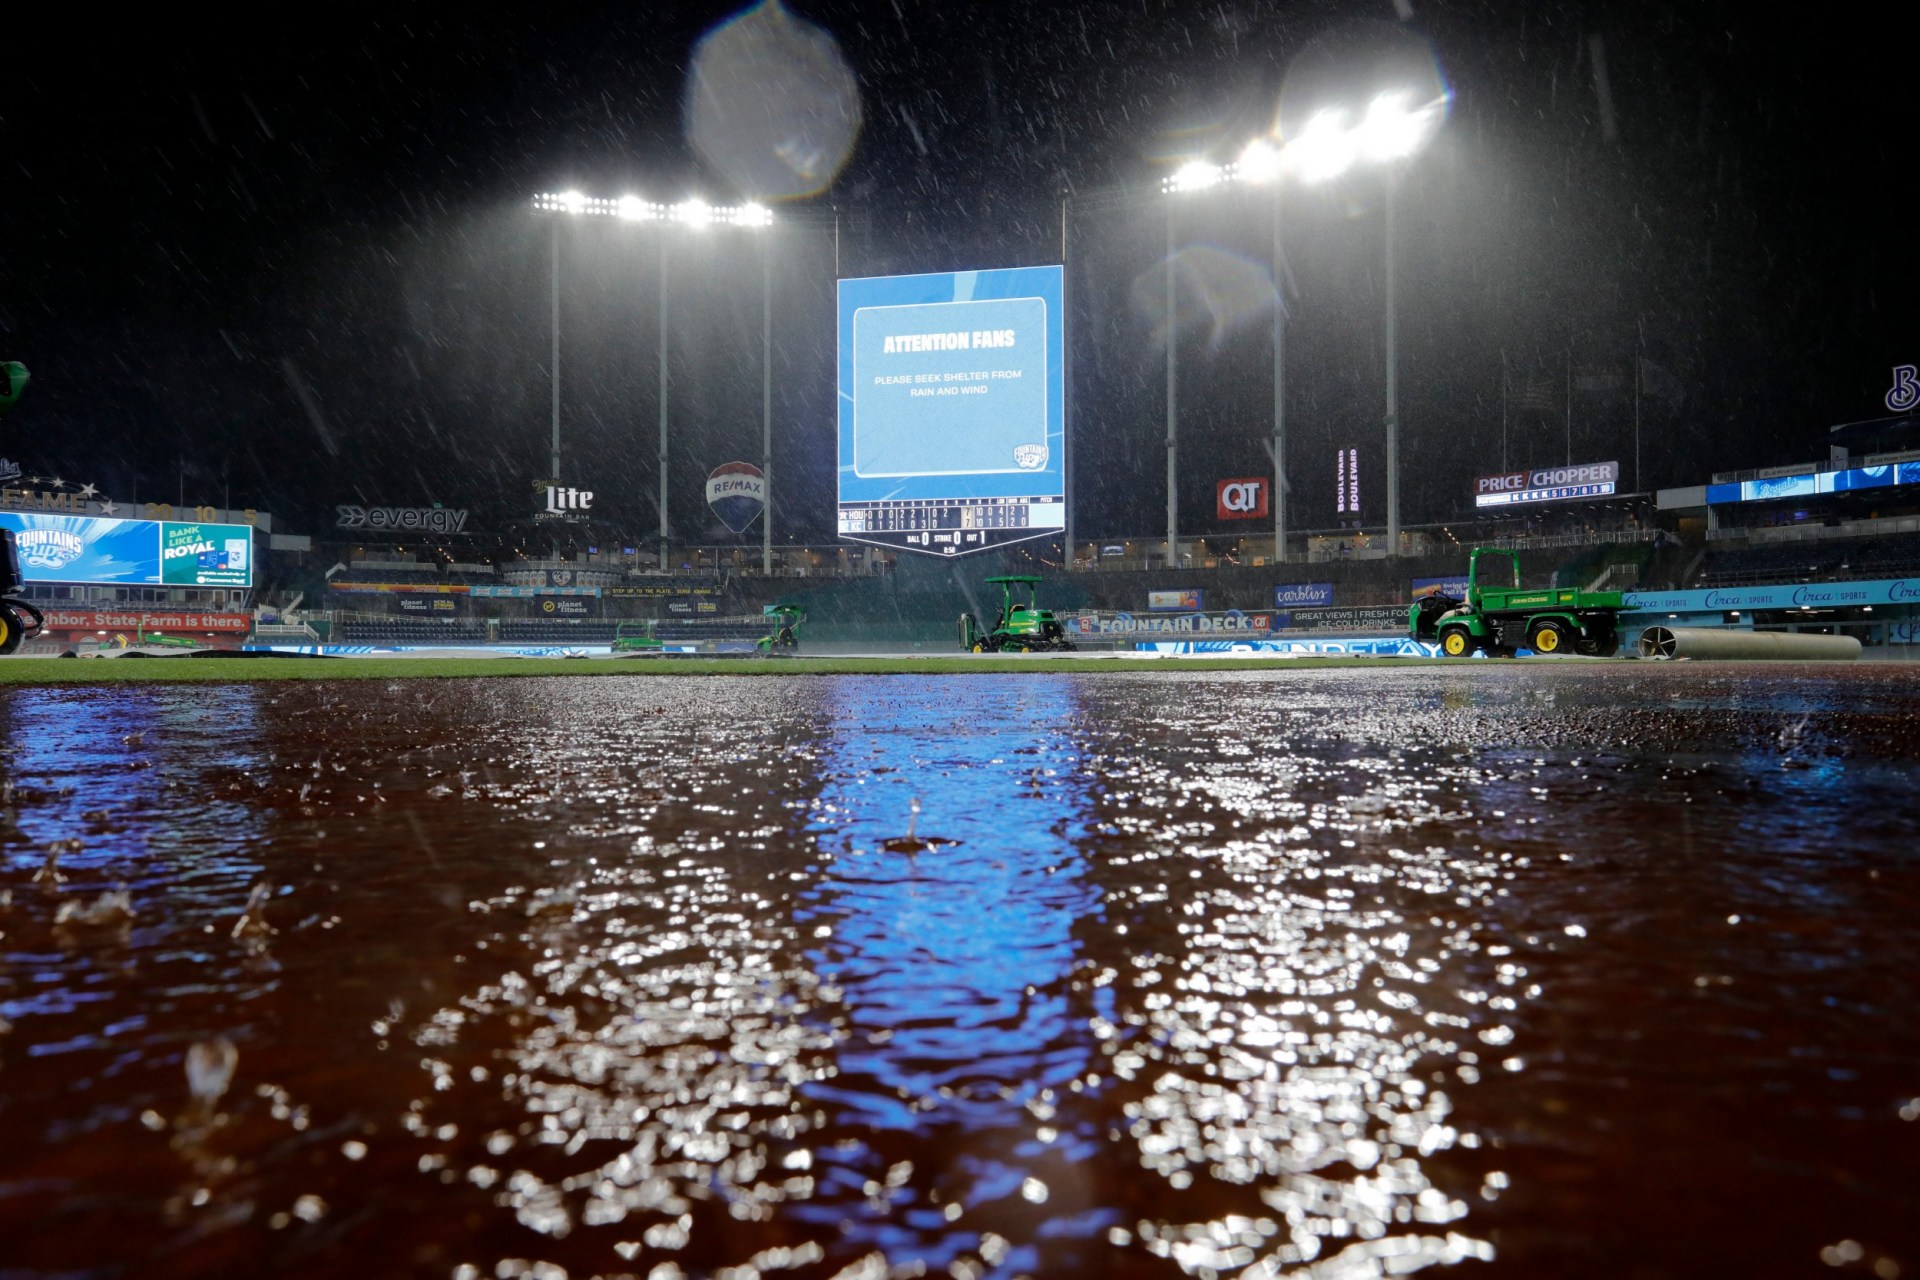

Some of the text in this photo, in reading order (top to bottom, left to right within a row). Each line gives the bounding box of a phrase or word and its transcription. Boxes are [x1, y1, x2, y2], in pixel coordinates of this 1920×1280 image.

[884, 329, 1015, 353] ATTENTION FANS
[875, 370, 1022, 385] PLEASE SEEK SHELTER FROM
[911, 385, 988, 397] RAIN AND WIND
[714, 481, 760, 494] RE/MAX
[1350, 449, 1359, 511] BOULEVARD
[1480, 466, 1611, 492] PRICE CHOPPER
[2, 489, 88, 512] FAME
[544, 486, 593, 514] Lite
[1222, 482, 1259, 511] QT
[144, 503, 256, 524] 20 10 5
[369, 507, 468, 532] evergy
[849, 510, 863, 520] HOU
[868, 510, 872, 519] 0
[878, 510, 883, 518] 0
[889, 510, 893, 518] 0
[900, 509, 904, 518] 2
[911, 509, 915, 518] 2
[922, 509, 925, 518] 1
[933, 509, 937, 517] 0
[944, 508, 948, 517] 2
[976, 507, 983, 516] 10
[988, 507, 992, 516] 0
[999, 507, 1003, 515] 4
[1010, 506, 1014, 515] 2
[1022, 506, 1025, 515] 1
[169, 526, 199, 538] BANK
[851, 522, 861, 531] KC
[868, 521, 872, 530] 0
[879, 521, 882, 529] 1
[889, 520, 893, 529] 2
[901, 520, 904, 529] 1
[911, 520, 915, 528] 0
[922, 520, 926, 528] 3
[933, 520, 937, 528] 0
[976, 519, 983, 527] 10
[989, 518, 992, 526] 1
[999, 518, 1004, 526] 5
[1010, 518, 1015, 526] 2
[1022, 517, 1026, 526] 0
[16, 530, 82, 553] FOUNTAINS
[169, 536, 192, 547] LIKE
[922, 532, 929, 545] 0
[954, 531, 961, 544] 0
[980, 531, 985, 544] 1
[165, 541, 215, 559] ROYAL
[1278, 582, 1328, 602] carbliss
[1705, 591, 1742, 608] Circa
[1793, 586, 1833, 605] Circa
[1888, 581, 1920, 601] Circ
[1625, 595, 1659, 608] Circa
[95, 614, 137, 626] State
[142, 614, 181, 626] Farm
[186, 615, 198, 626] is
[202, 616, 245, 627] there.
[1360, 610, 1387, 618] FRESH
[1100, 616, 1266, 634] FOUNTAIN DECK QT
[1318, 619, 1396, 628] ICE-COLD DRINKS
